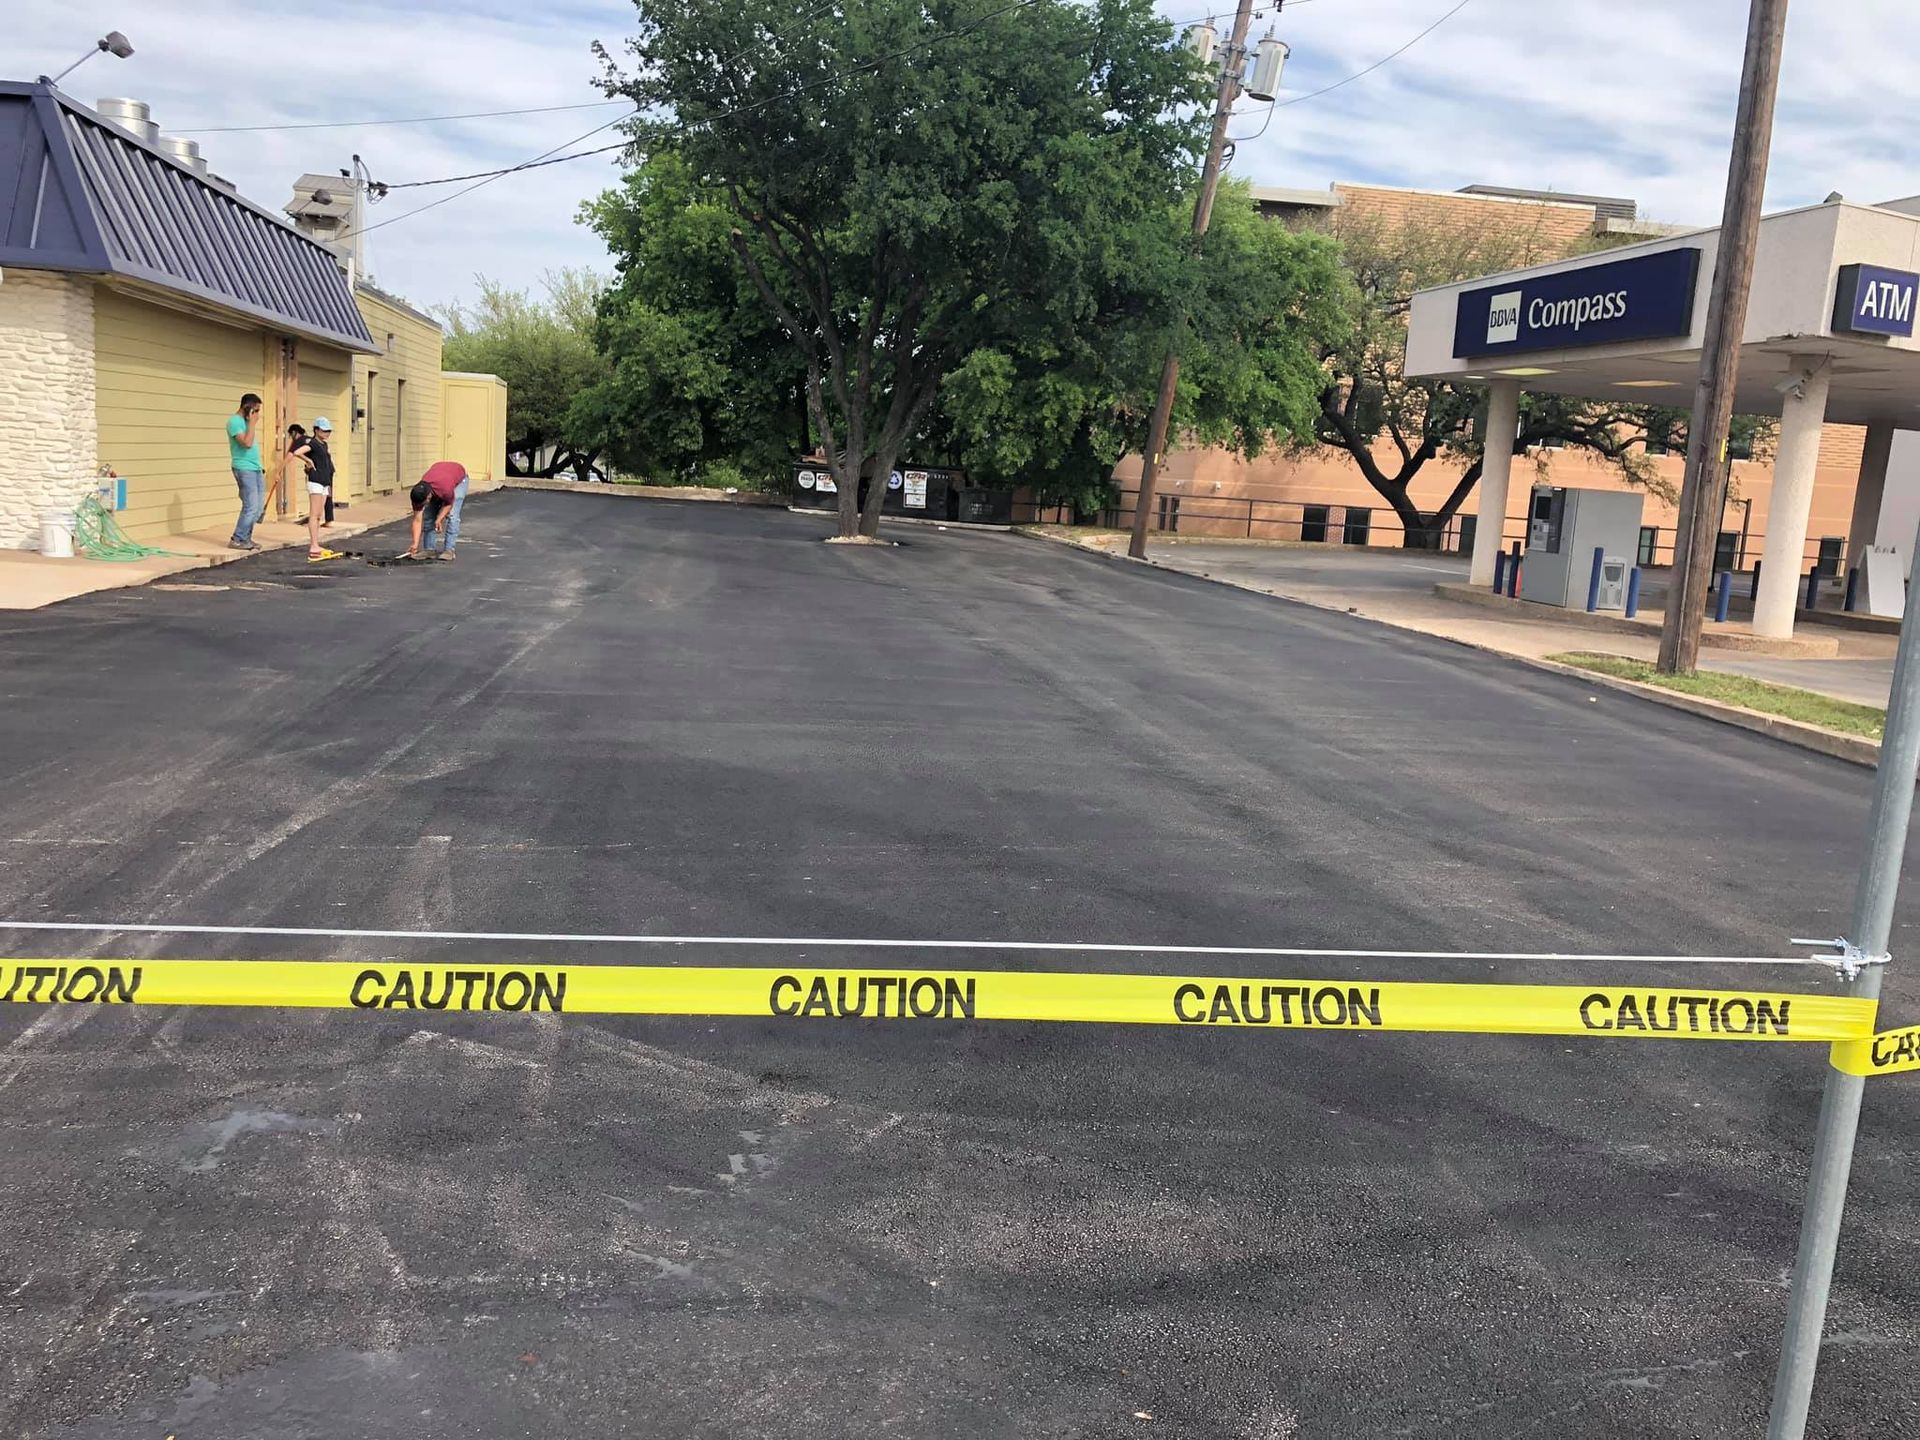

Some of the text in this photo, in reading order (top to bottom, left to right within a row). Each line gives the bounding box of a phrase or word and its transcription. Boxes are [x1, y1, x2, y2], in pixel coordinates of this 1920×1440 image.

[1489, 290, 1628, 332] BBVA Compass
[1860, 280, 1912, 322] ATM
[350, 969, 567, 1012] CAUTION
[769, 975, 976, 1018] CAUTION
[1173, 983, 1383, 1026] CAUTION
[1579, 993, 1791, 1035] CAUTION
[1872, 1031, 1920, 1067] CA
